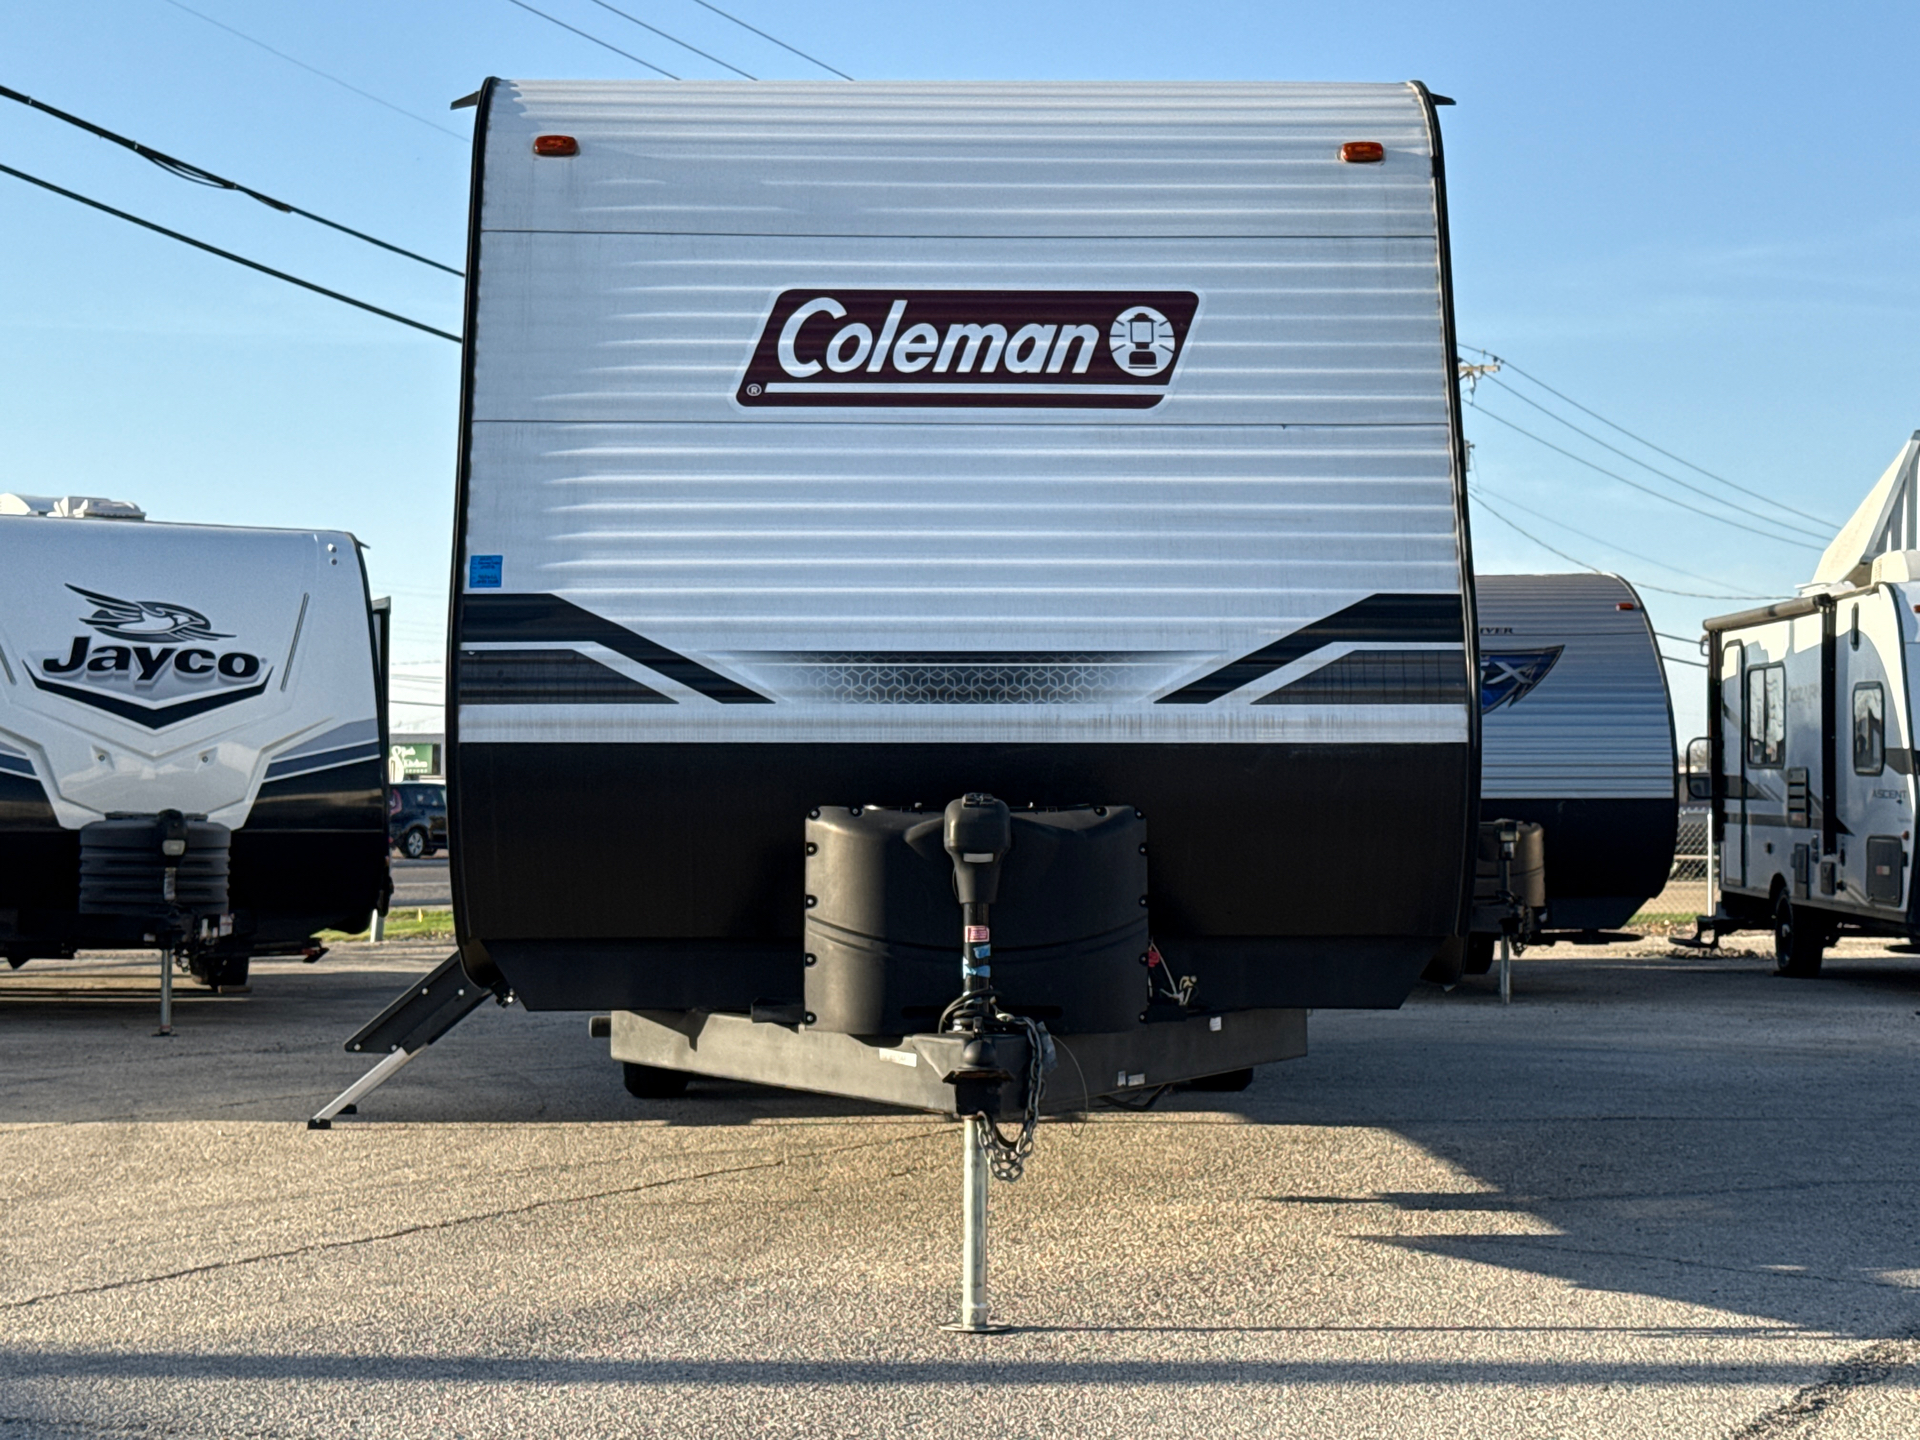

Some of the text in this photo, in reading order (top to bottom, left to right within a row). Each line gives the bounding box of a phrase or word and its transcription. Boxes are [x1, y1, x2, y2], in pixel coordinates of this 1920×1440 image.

[777, 297, 1100, 378] Coleman
[42, 636, 261, 682] Jayco
[1872, 789, 1907, 800] ASCENT
